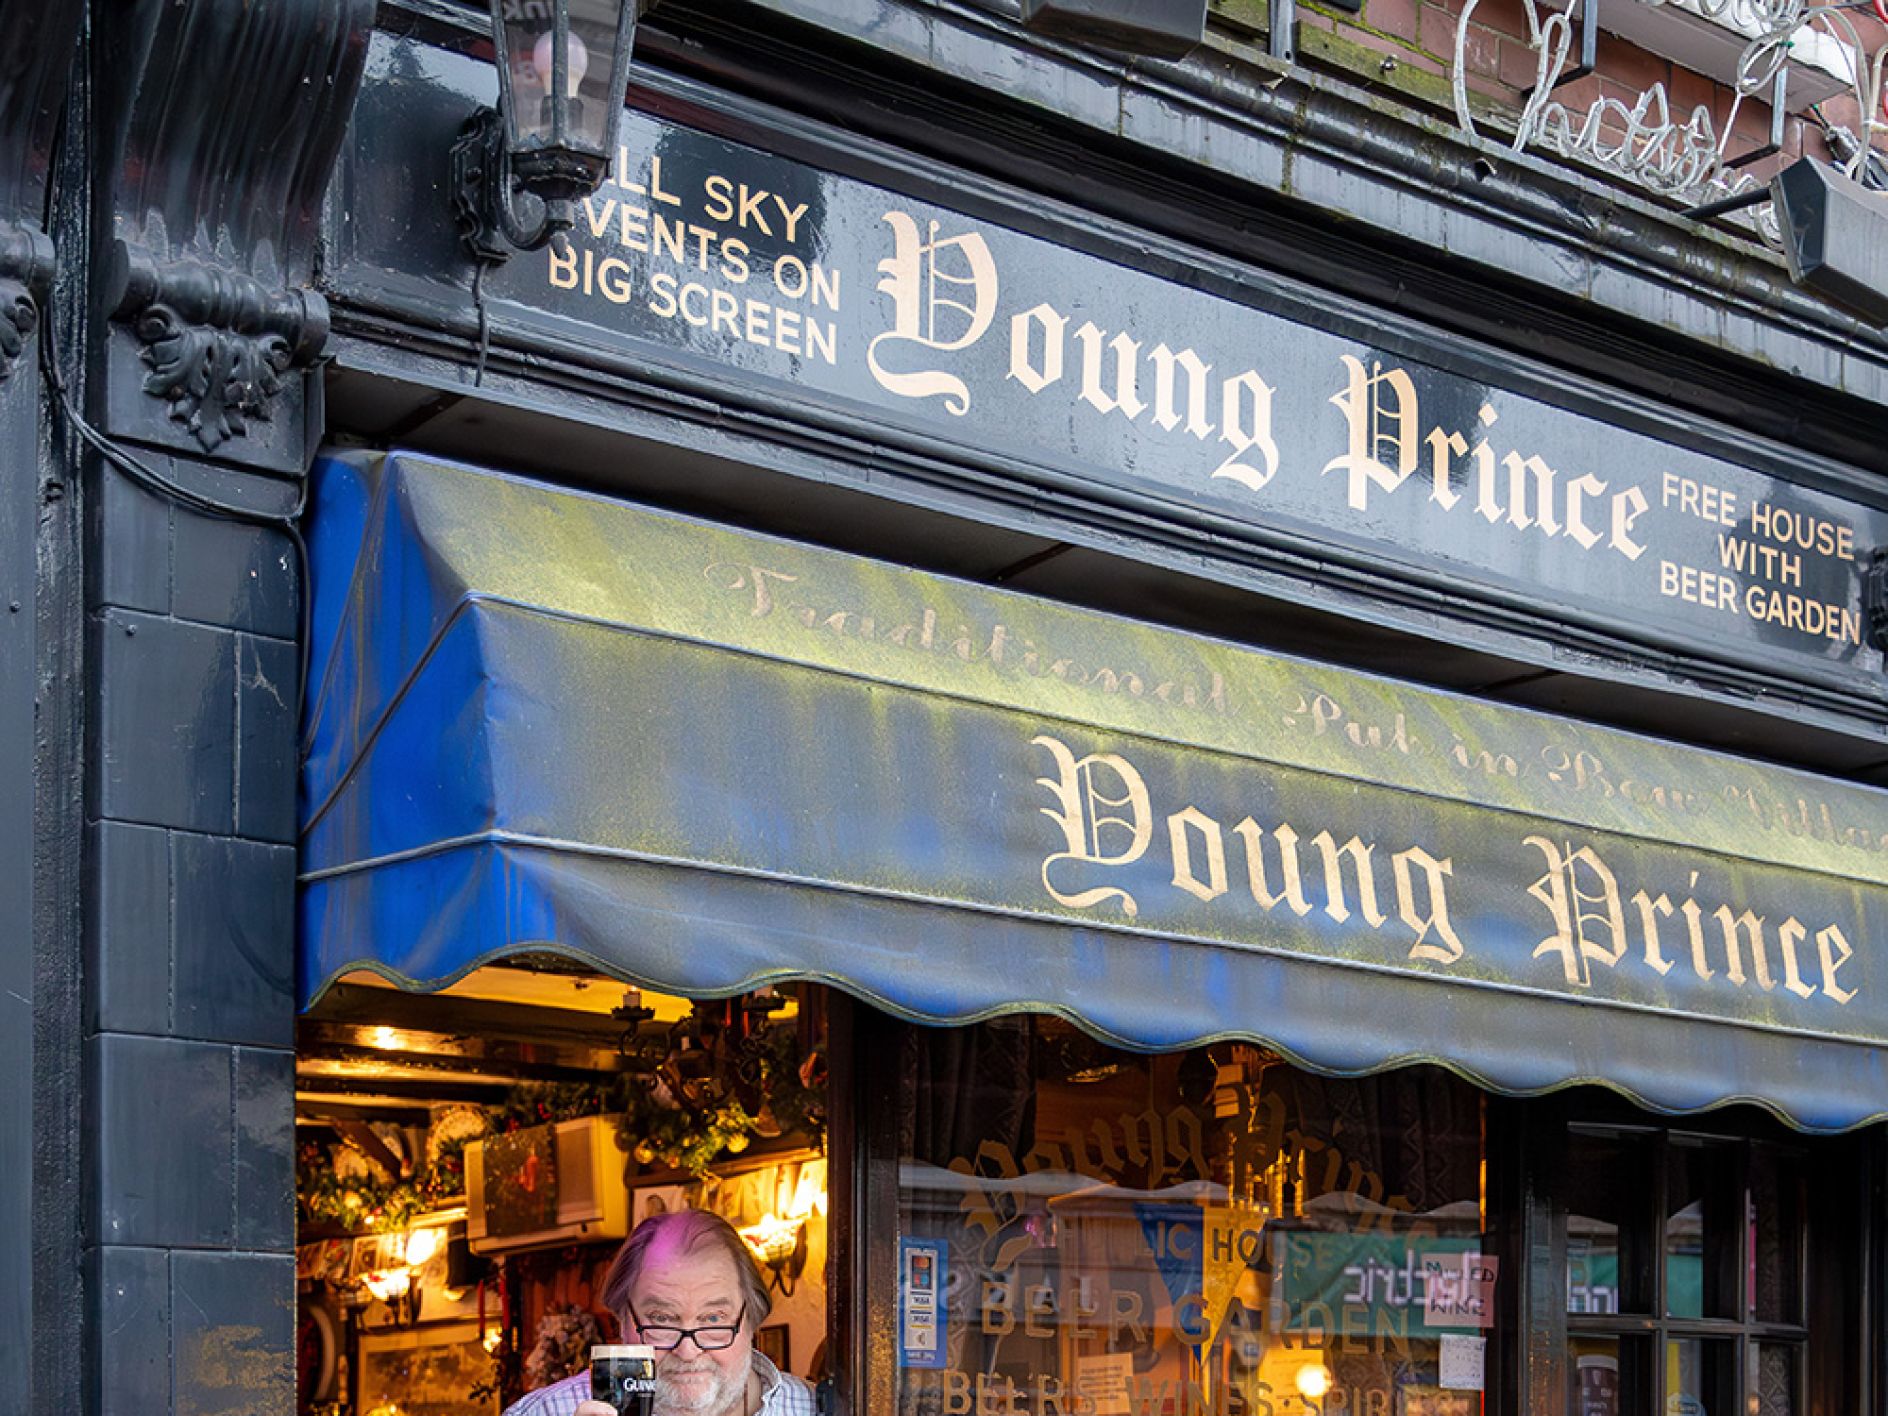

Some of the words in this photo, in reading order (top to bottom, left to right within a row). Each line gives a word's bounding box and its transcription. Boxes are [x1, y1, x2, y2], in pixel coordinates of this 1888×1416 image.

[606, 145, 681, 206] LL
[703, 175, 809, 243] SKY
[583, 197, 751, 284] VENTS
[773, 254, 841, 312] ON
[549, 243, 632, 304] BIG
[649, 273, 837, 365] SCREEN
[867, 210, 1280, 492] Young
[1322, 354, 1648, 560] Prince
[1662, 471, 1738, 528] FREE
[1751, 500, 1855, 561] HOUSE
[1717, 532, 1801, 587] WITH
[703, 562, 1236, 718] Traditional
[1660, 560, 1739, 614] BEER
[1745, 585, 1861, 645] GARDEN
[1030, 735, 1464, 965] Young
[1521, 834, 1858, 1004] Prince
[1212, 1226, 1337, 1277] HOSE
[980, 1279, 1146, 1346] BEER
[1171, 1296, 1415, 1365] GARDEN
